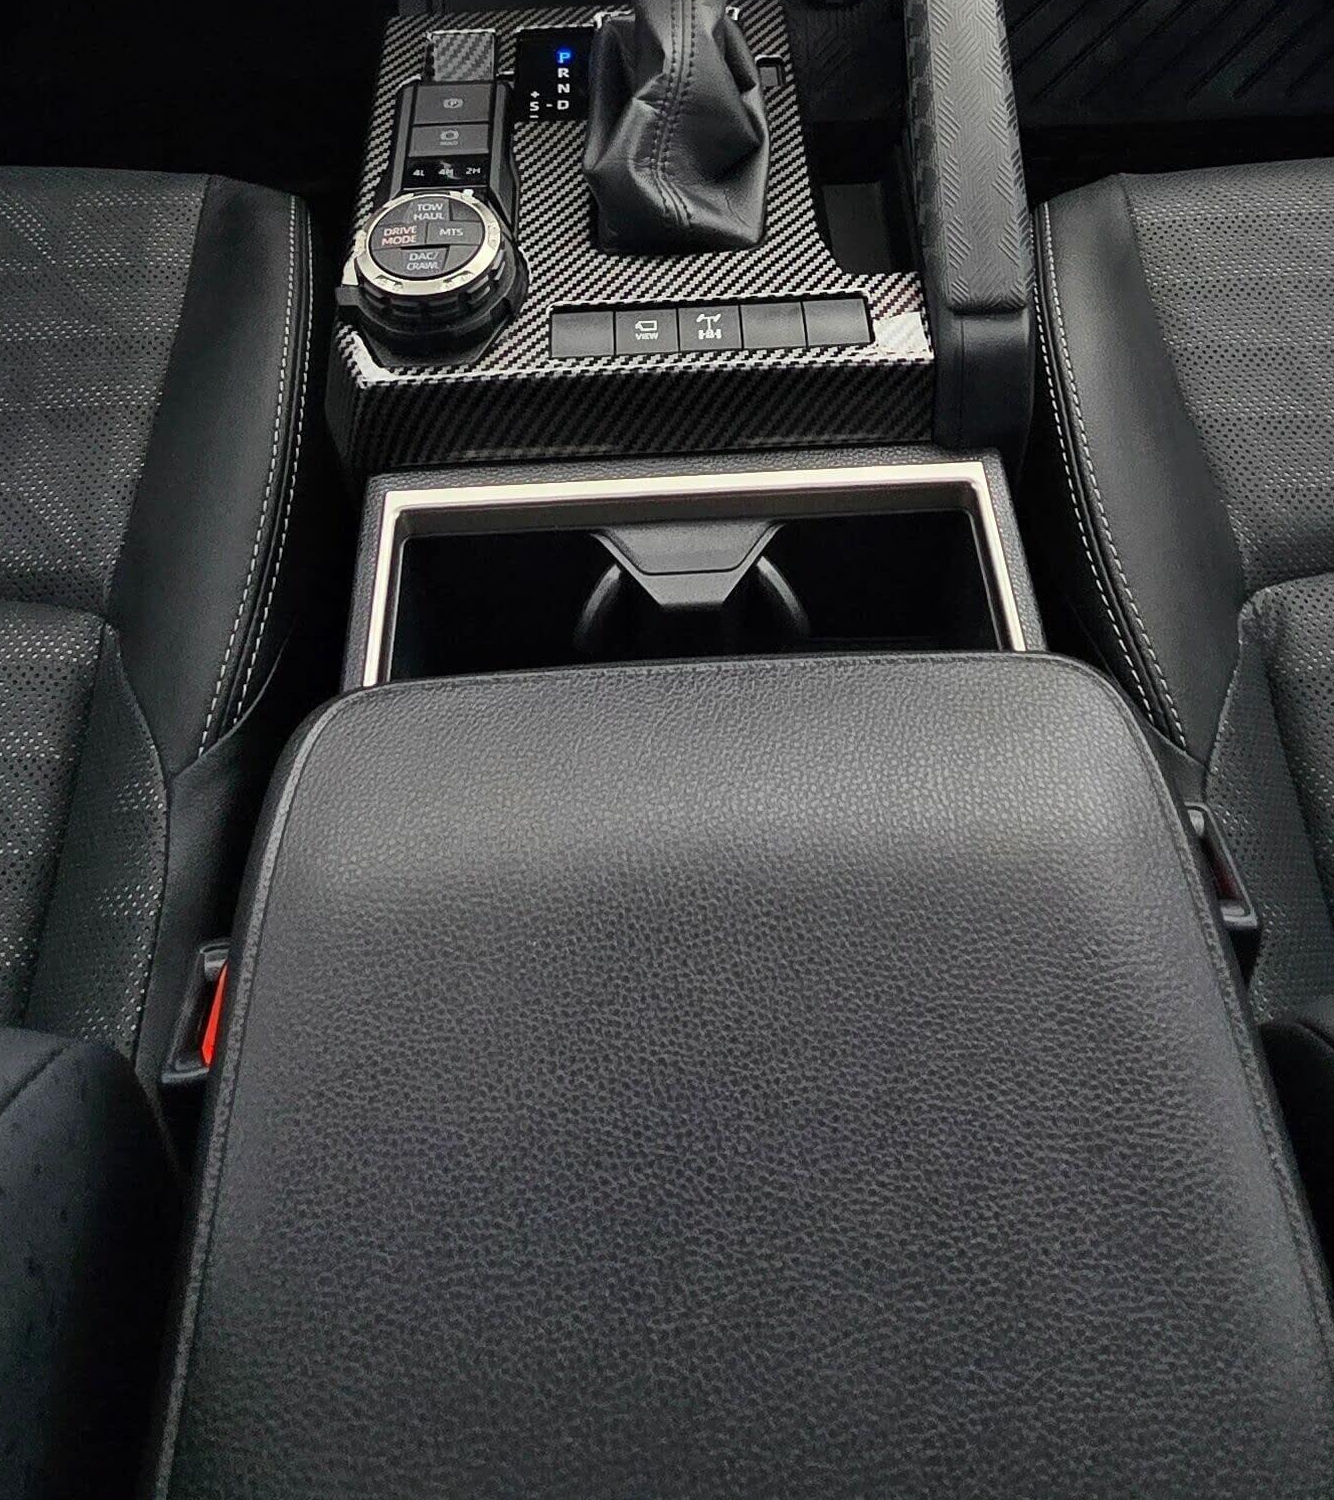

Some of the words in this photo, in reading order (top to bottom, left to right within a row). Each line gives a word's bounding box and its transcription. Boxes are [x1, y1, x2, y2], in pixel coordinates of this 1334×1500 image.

[559, 52, 571, 64] P
[558, 68, 570, 78] R
[558, 83, 570, 94] N
[529, 101, 540, 112] S
[557, 100, 569, 110] D
[412, 168, 425, 177] 4L
[466, 167, 481, 175] 2H
[417, 203, 444, 212] TOW
[413, 212, 445, 221] HAUL
[384, 226, 418, 236] DRIVE
[439, 228, 464, 237] MTS
[382, 235, 417, 246] MODE
[409, 251, 439, 261] DAC/
[407, 261, 440, 271] CRAWL
[635, 332, 659, 340] VIEW
